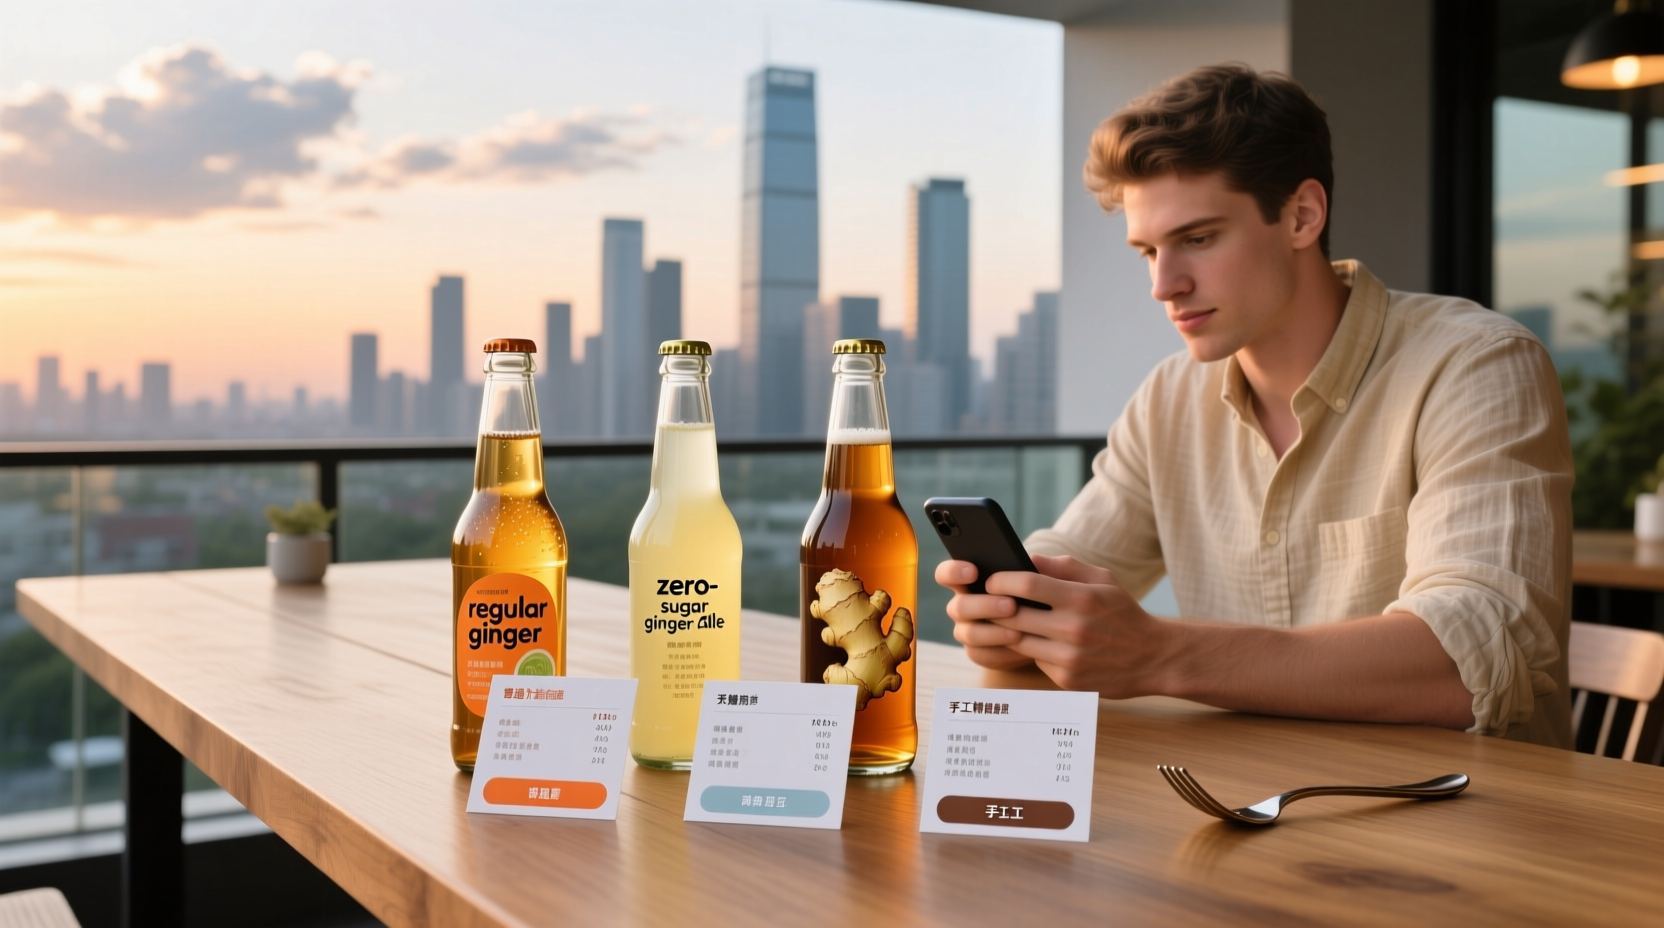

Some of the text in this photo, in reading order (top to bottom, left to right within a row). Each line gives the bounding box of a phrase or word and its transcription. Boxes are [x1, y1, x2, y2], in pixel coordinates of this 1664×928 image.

[657, 579, 718, 596] zero-
[468, 595, 549, 625] regular
[661, 602, 709, 618] sugar
[644, 615, 694, 635] ginger
[468, 621, 542, 650] ginger
